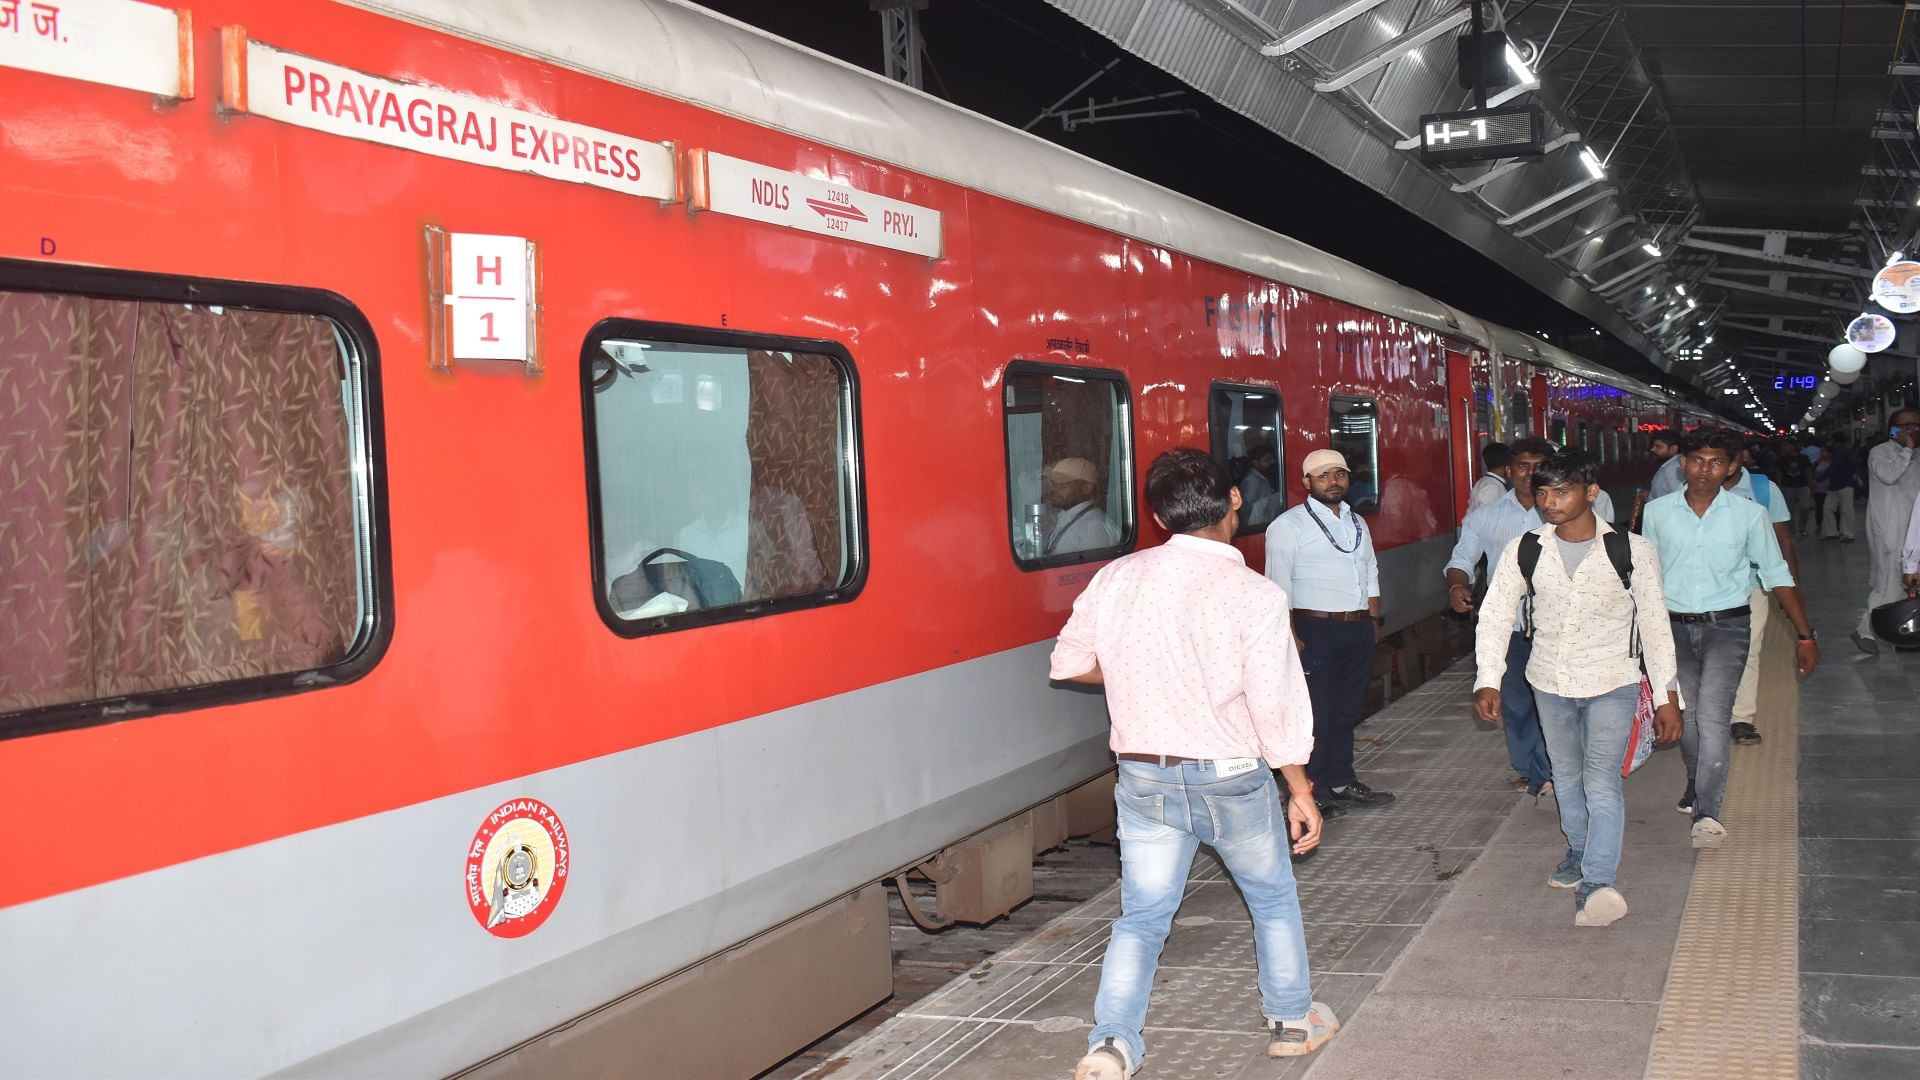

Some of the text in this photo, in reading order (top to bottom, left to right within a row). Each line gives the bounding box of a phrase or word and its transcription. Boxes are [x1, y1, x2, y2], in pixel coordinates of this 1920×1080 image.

[284, 65, 641, 182] PRAYAGRAJ EXPRESS
[1425, 119, 1486, 145] H-1
[752, 178, 790, 211] NDLS
[827, 190, 849, 205] 12418
[826, 218, 848, 232] 12417
[883, 209, 918, 239] PRYJ.
[41, 237, 56, 256] D
[476, 255, 502, 286] H
[480, 312, 500, 342] 1
[721, 313, 728, 327] E
[1229, 762, 1253, 772] DIESEL
[490, 801, 568, 878] INDIAN RAILWAYS
